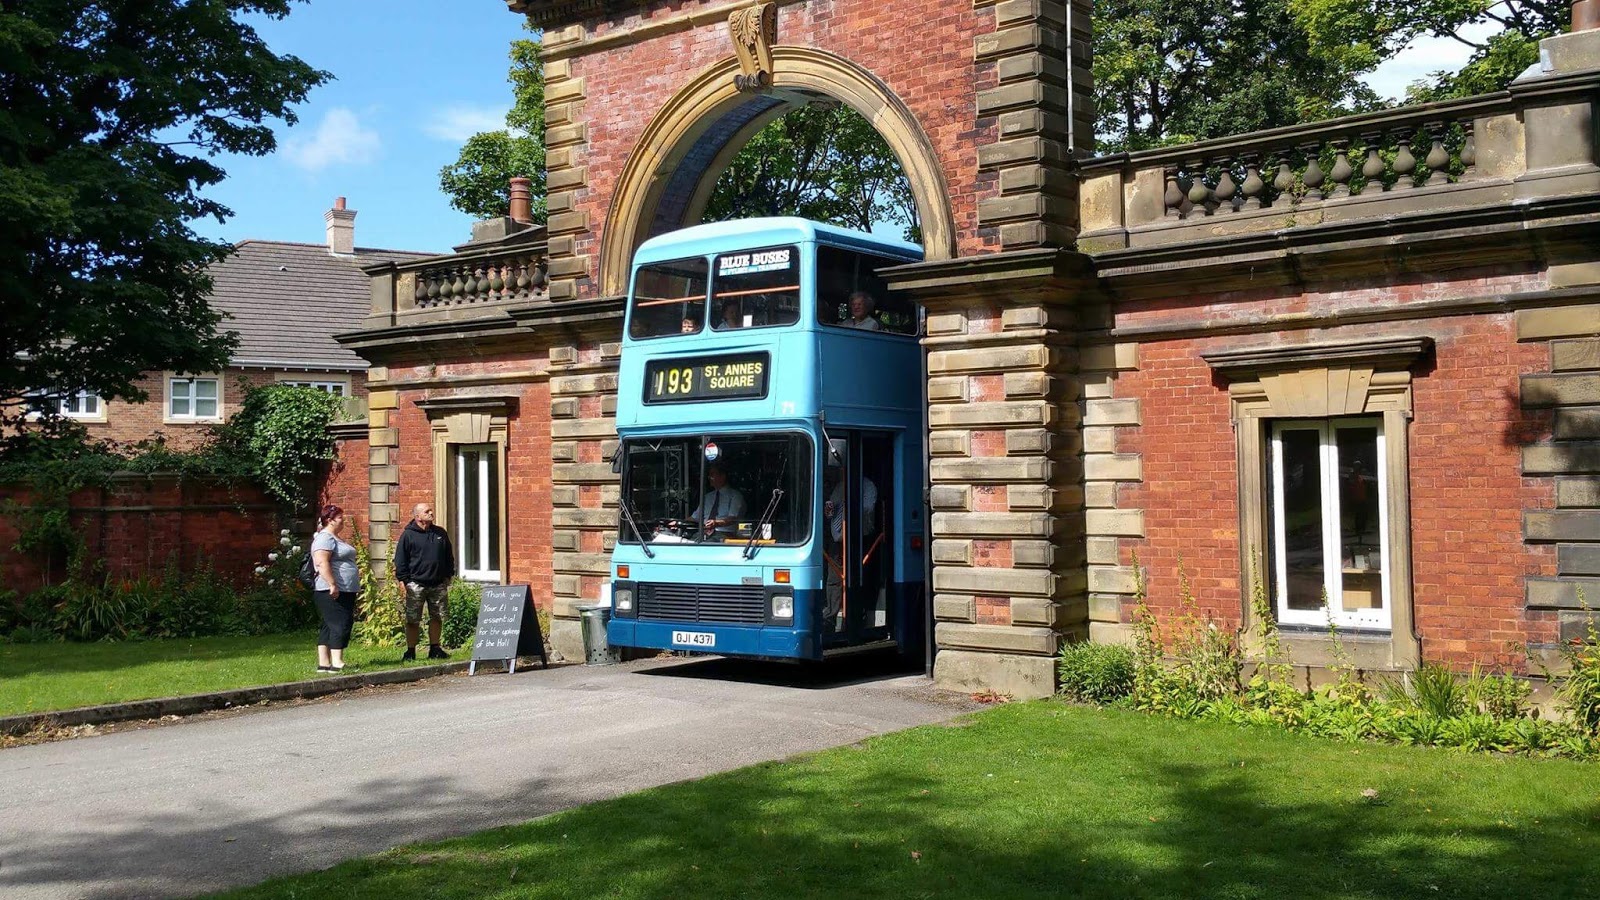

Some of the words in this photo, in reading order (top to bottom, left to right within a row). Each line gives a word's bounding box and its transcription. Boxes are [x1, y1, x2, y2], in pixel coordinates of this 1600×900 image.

[720, 254, 750, 269] BLUE
[751, 249, 790, 265] BUSES
[704, 365, 721, 377] ST.
[725, 362, 762, 376] ANNES
[656, 368, 693, 395] 193
[710, 375, 754, 389] SQUARE
[485, 590, 506, 598] Thank
[510, 592, 521, 600] you
[483, 604, 497, 612] Your
[483, 614, 516, 624] essential
[478, 627, 488, 635] for
[476, 639, 483, 648] of
[485, 639, 495, 647] the
